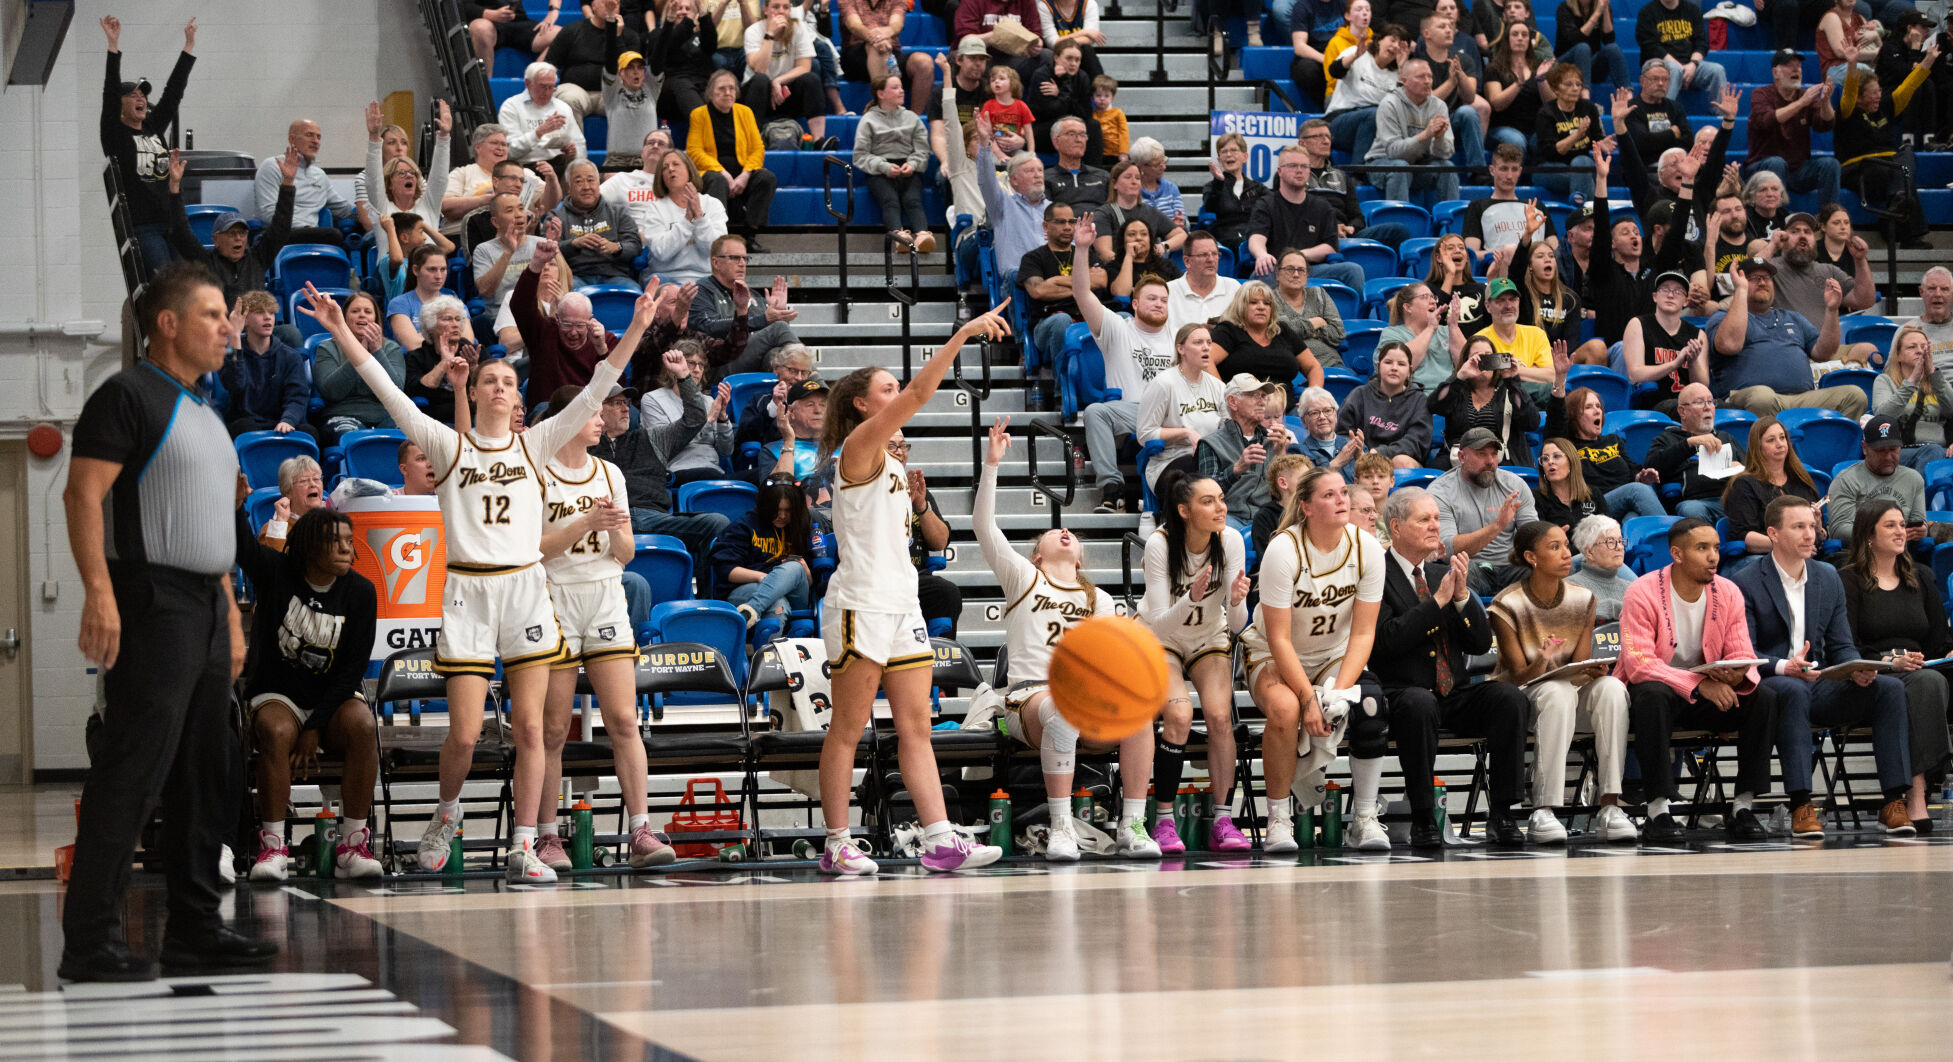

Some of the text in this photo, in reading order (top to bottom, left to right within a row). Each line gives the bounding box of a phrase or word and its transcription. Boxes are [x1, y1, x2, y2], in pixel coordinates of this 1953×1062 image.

[1225, 116, 1297, 139] SECTION
[892, 305, 900, 318] J
[923, 347, 933, 361] H
[956, 393, 968, 406] G
[459, 462, 528, 488] The Dons
[1033, 492, 1044, 506] E
[482, 495, 511, 525] 12
[548, 501, 576, 522] The
[390, 533, 422, 570] G
[944, 547, 956, 561] D
[1293, 583, 1356, 608] The Dons
[1031, 594, 1060, 613] The
[986, 606, 999, 620] C
[1310, 614, 1338, 637] 21
[394, 660, 432, 672] PUR
[640, 652, 715, 666] PURDUE
[407, 671, 430, 680] FORT
[651, 665, 705, 674] FORT WAYNE
